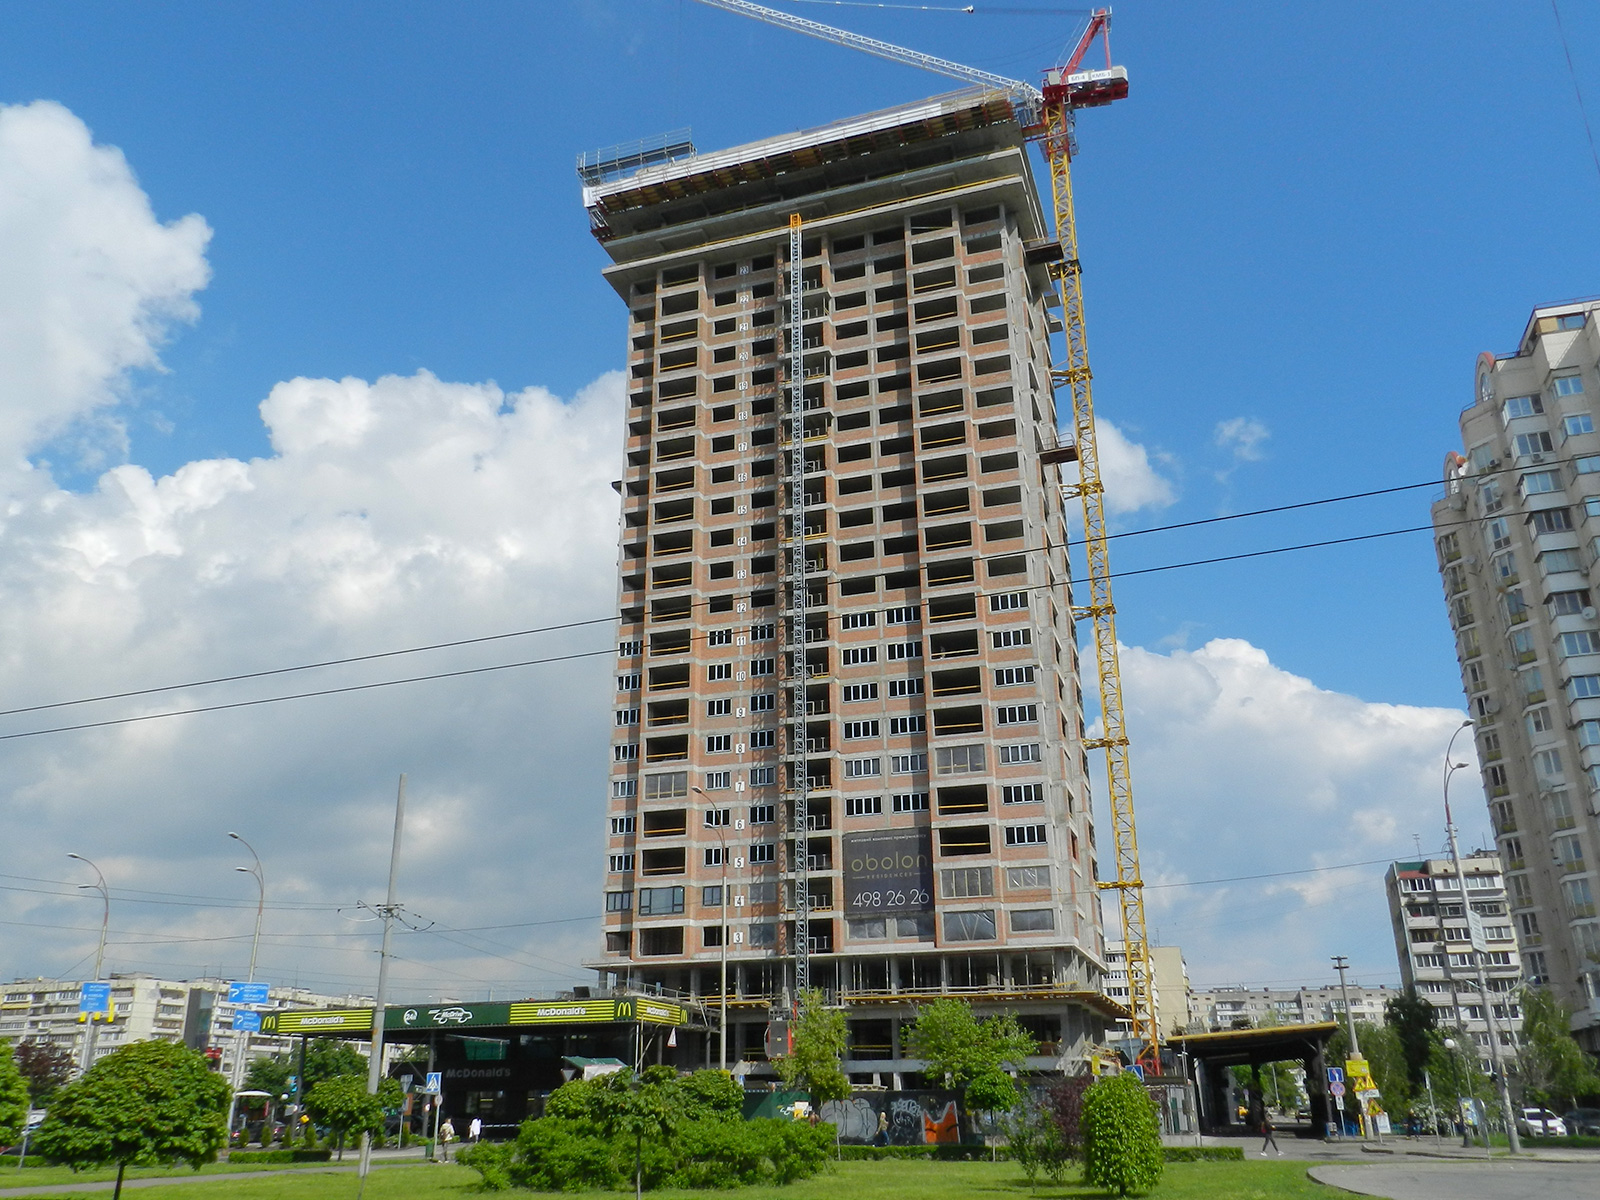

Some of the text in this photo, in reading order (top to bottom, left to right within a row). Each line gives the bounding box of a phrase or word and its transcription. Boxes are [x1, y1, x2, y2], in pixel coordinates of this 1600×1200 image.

[740, 296, 748, 304] 22
[740, 323, 748, 331] 21
[739, 352, 748, 360] 20
[739, 382, 747, 390] 19
[739, 411, 747, 420] 18
[739, 443, 747, 451] 17
[739, 473, 747, 482] 16
[738, 506, 747, 514] 15
[738, 537, 746, 546] 14
[737, 570, 746, 579] 13
[737, 604, 746, 613] 12
[738, 637, 745, 646] 11
[737, 671, 745, 681] 10
[851, 851, 928, 872] obolon
[852, 888, 930, 908] 498 26 26
[441, 1010, 464, 1018] McDrive
[536, 1006, 587, 1017] McDonald's
[300, 1015, 345, 1026] McDonald's
[446, 1067, 511, 1079] McDonald's
